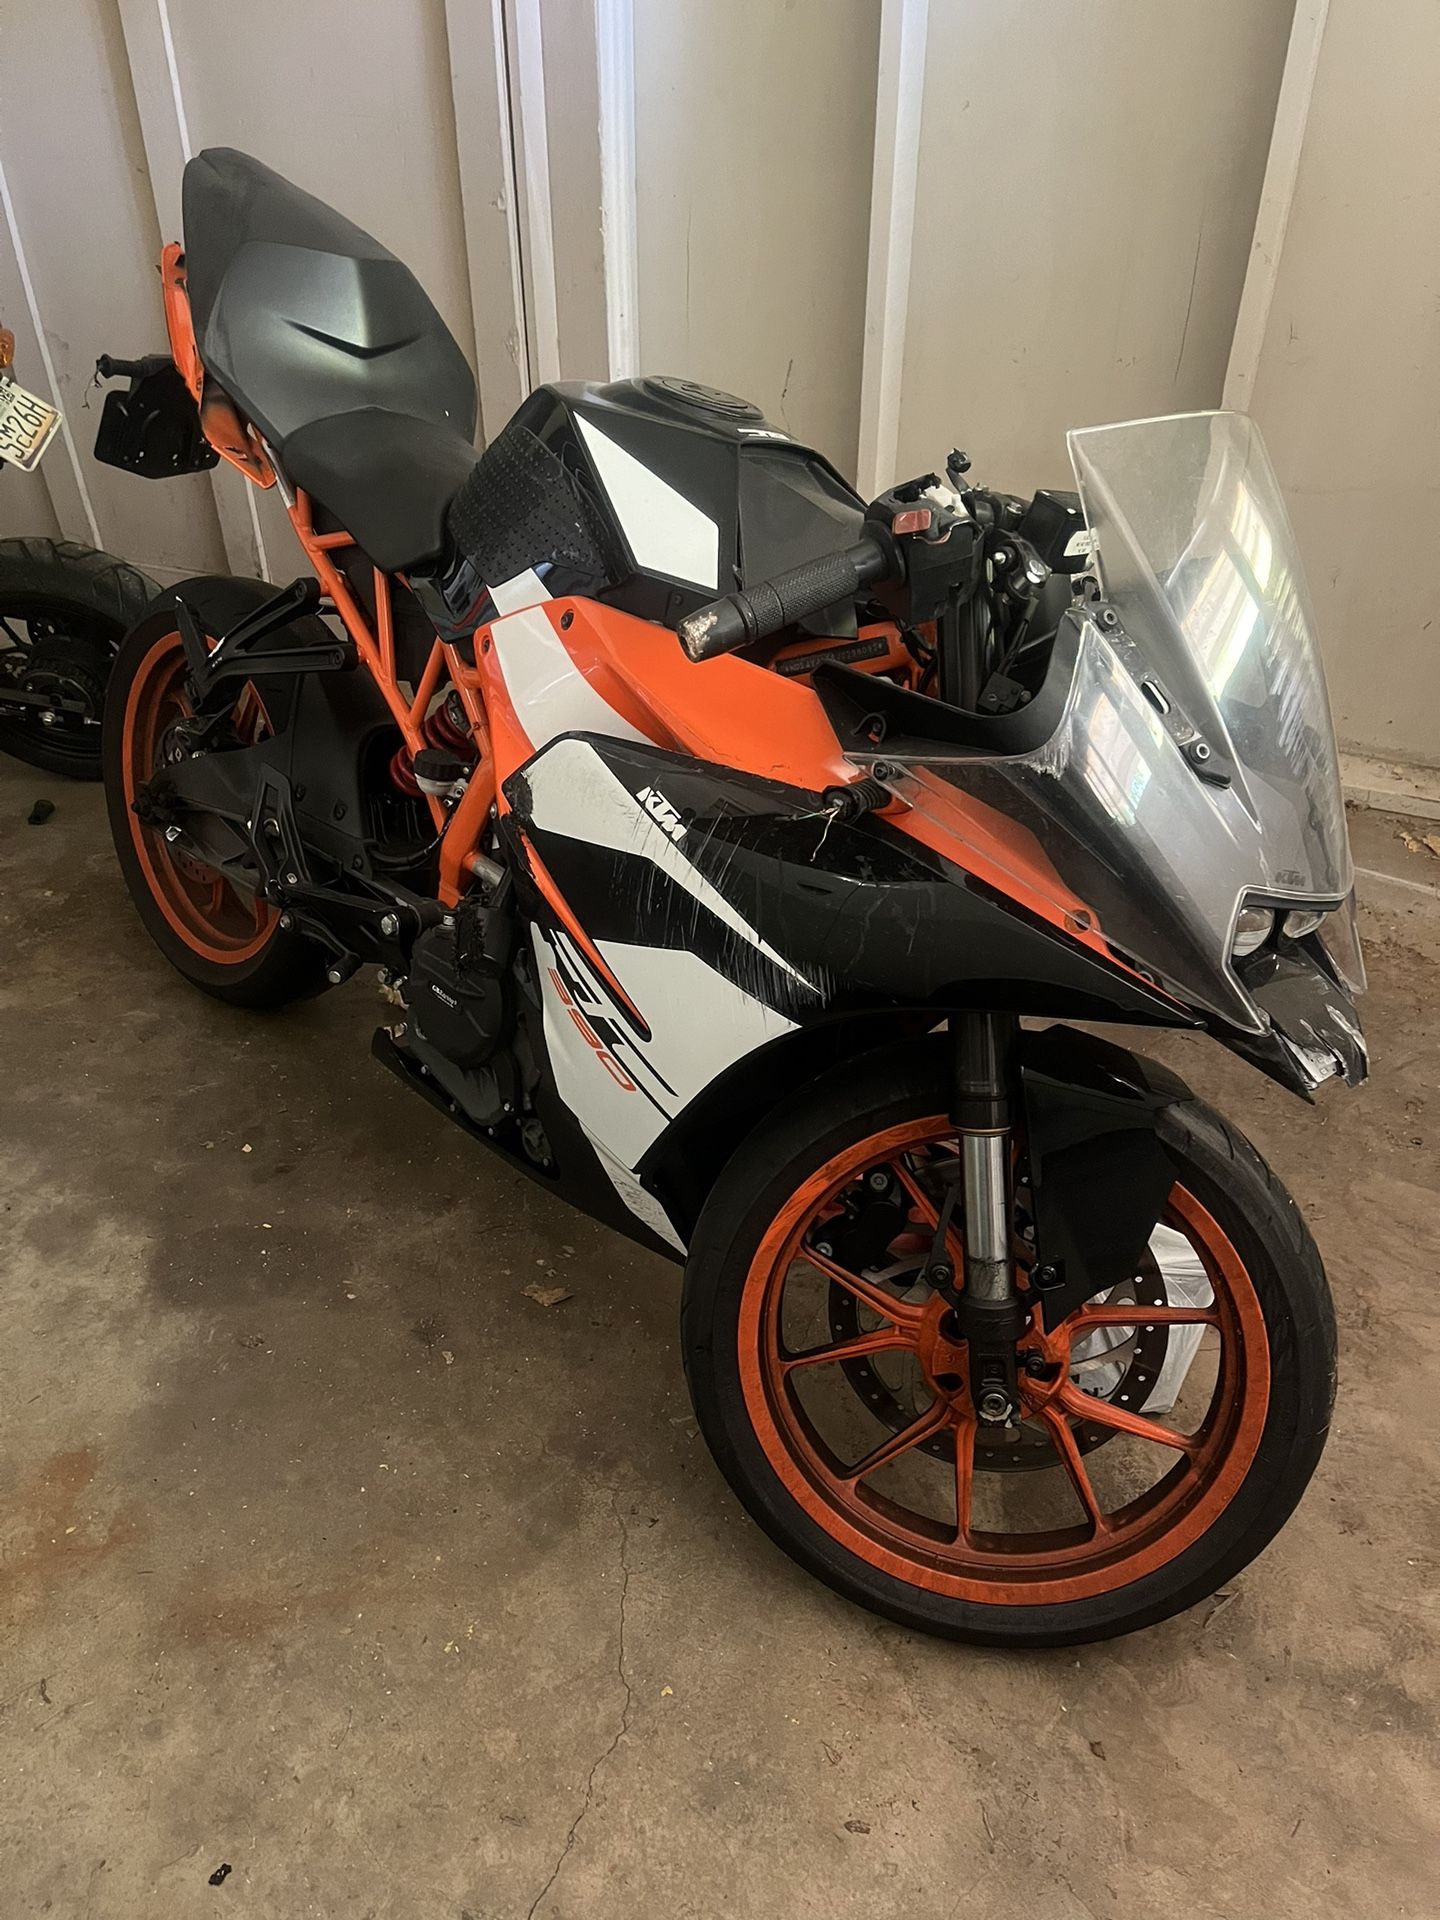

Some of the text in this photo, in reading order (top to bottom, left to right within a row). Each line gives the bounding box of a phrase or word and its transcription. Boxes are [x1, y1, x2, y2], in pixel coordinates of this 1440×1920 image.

[636, 786, 687, 842] KTM
[1274, 869, 1306, 887] KTM
[547, 967, 637, 1092] 390
